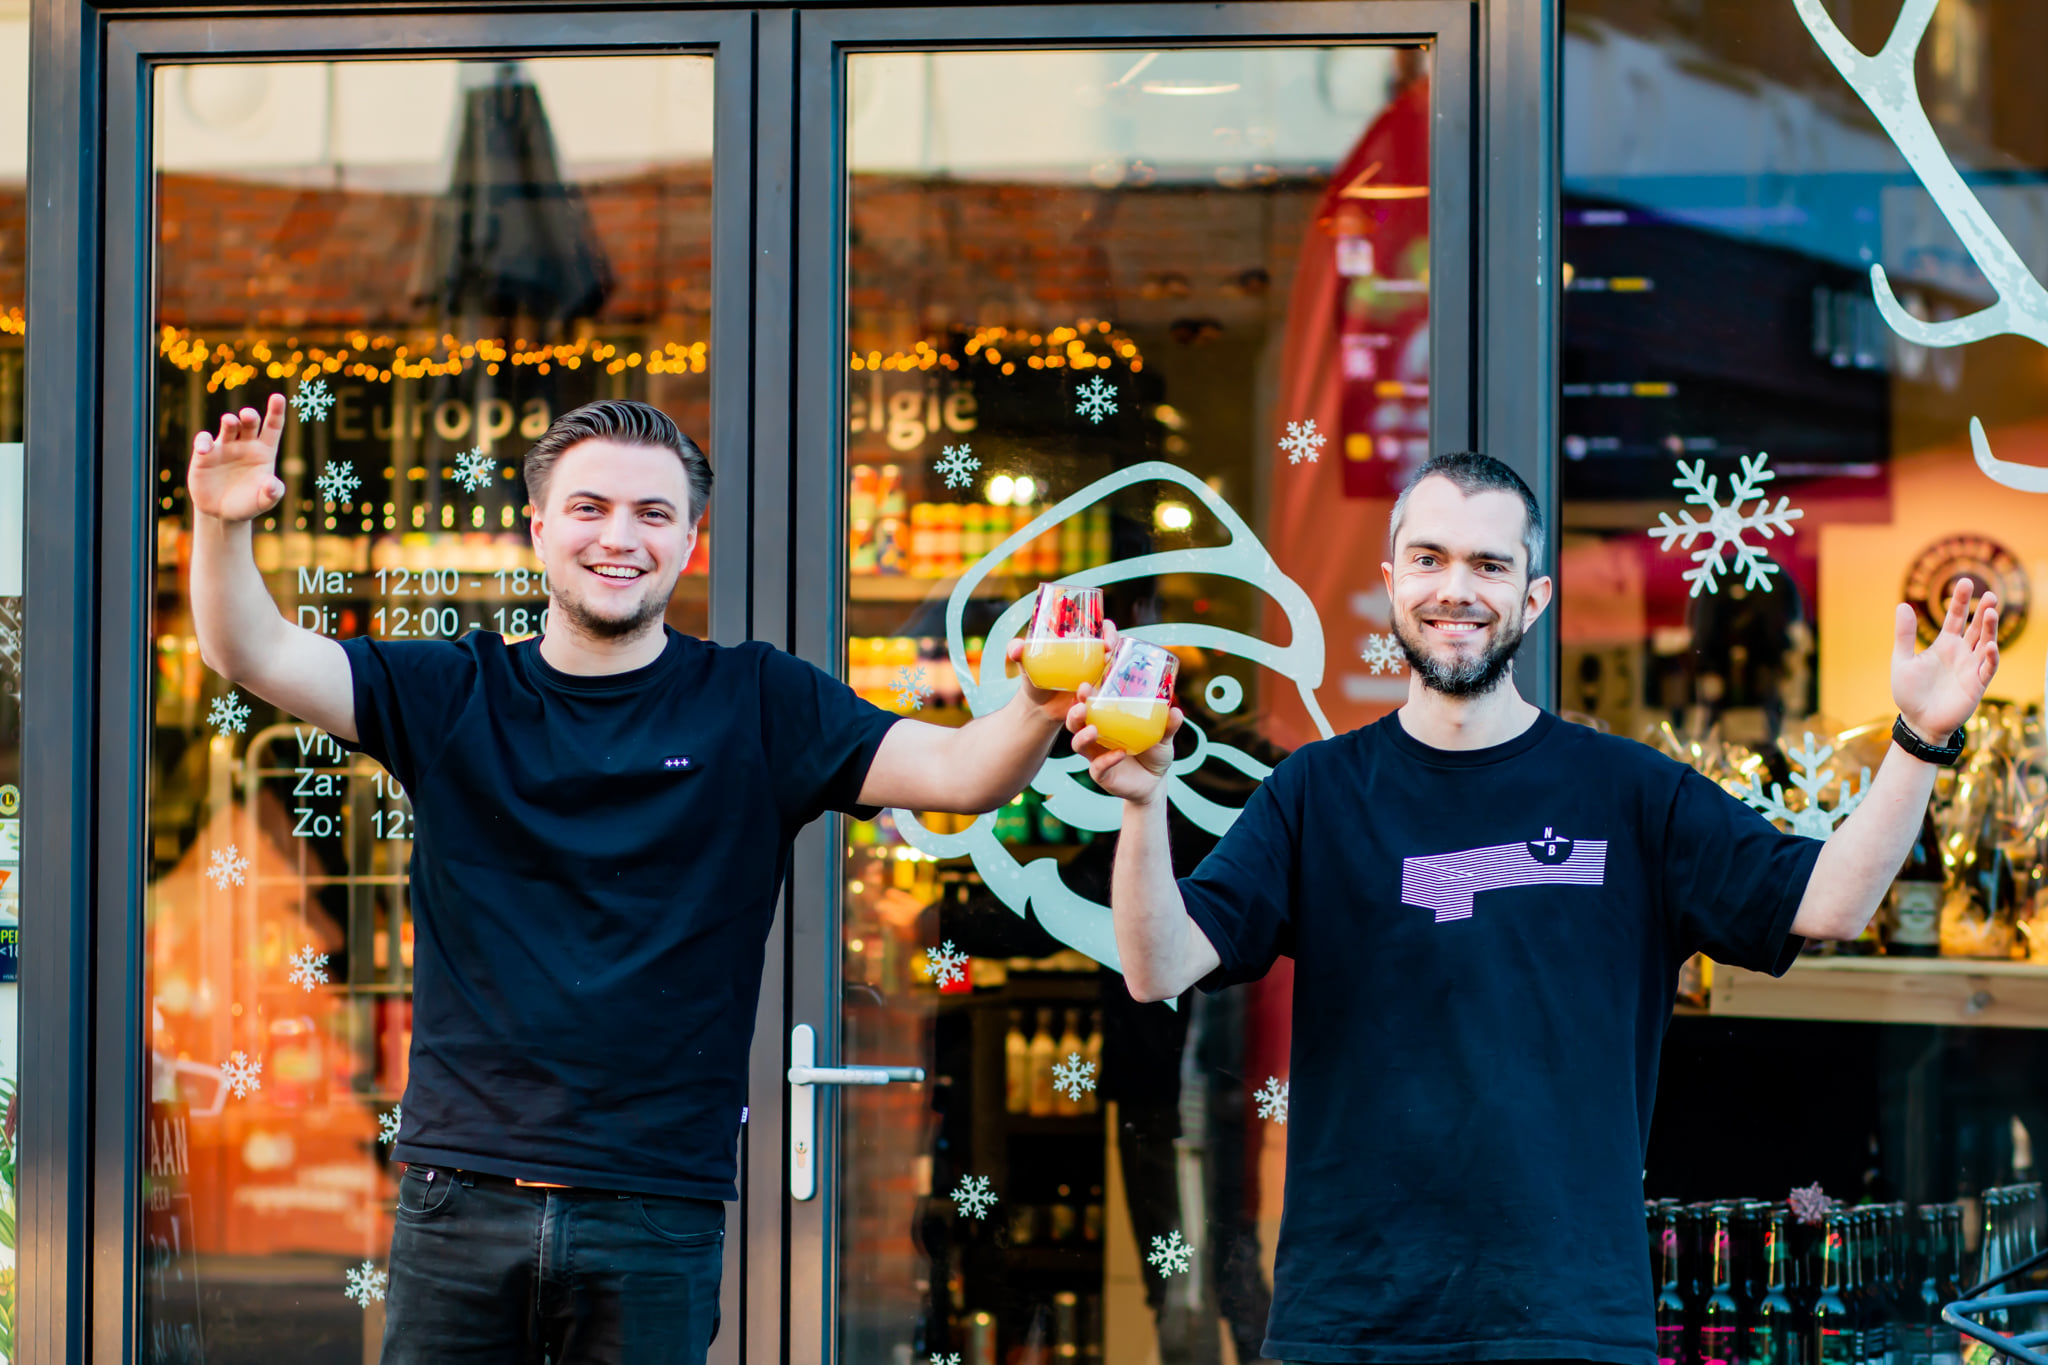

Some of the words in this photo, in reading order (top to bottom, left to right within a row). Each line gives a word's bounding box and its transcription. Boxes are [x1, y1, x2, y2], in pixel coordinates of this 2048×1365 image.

[335, 387, 551, 454] Europa
[297, 566, 352, 594] Ma:
[374, 567, 459, 596] 12:00
[297, 605, 337, 634] Di:
[374, 607, 459, 636] 12:00
[292, 767, 341, 797] Za:
[291, 807, 341, 837] Zo:
[371, 809, 415, 840] 12:
[1544, 826, 1553, 839] N
[1548, 844, 1556, 856] B
